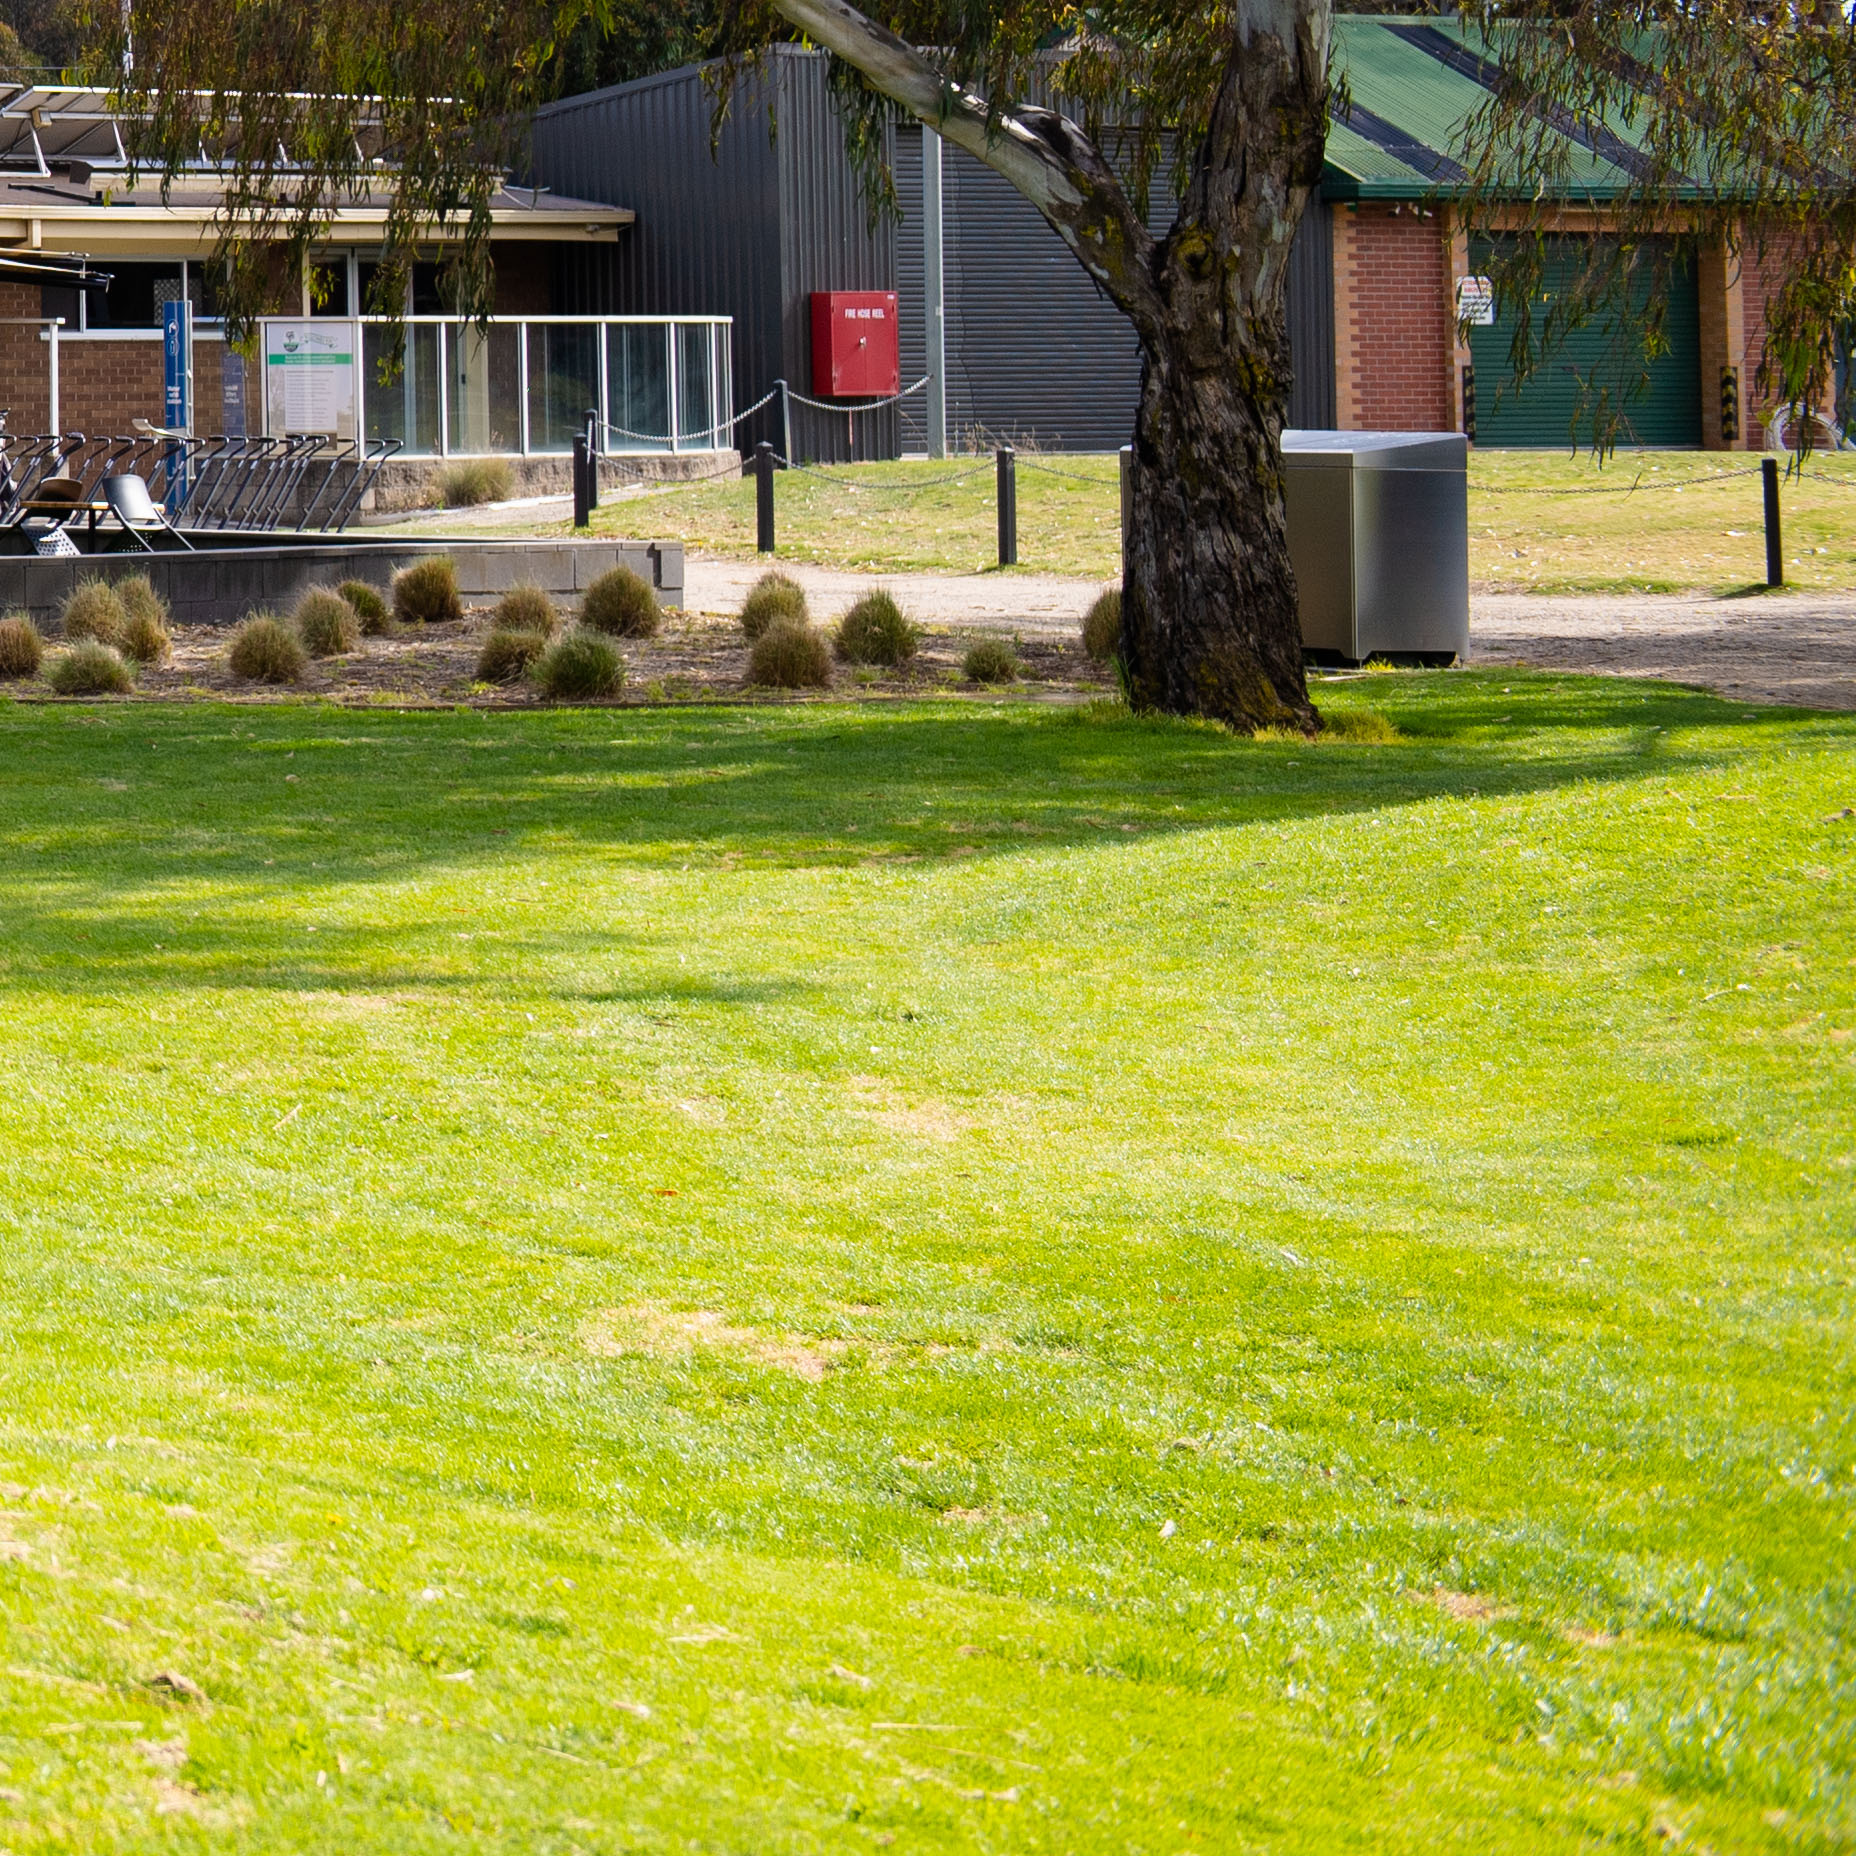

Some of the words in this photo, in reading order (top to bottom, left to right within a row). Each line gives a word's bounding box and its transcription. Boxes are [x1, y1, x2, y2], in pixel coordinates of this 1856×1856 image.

[845, 308, 856, 319] FIRE
[857, 308, 871, 319] HOSE
[872, 308, 885, 319] REEL
